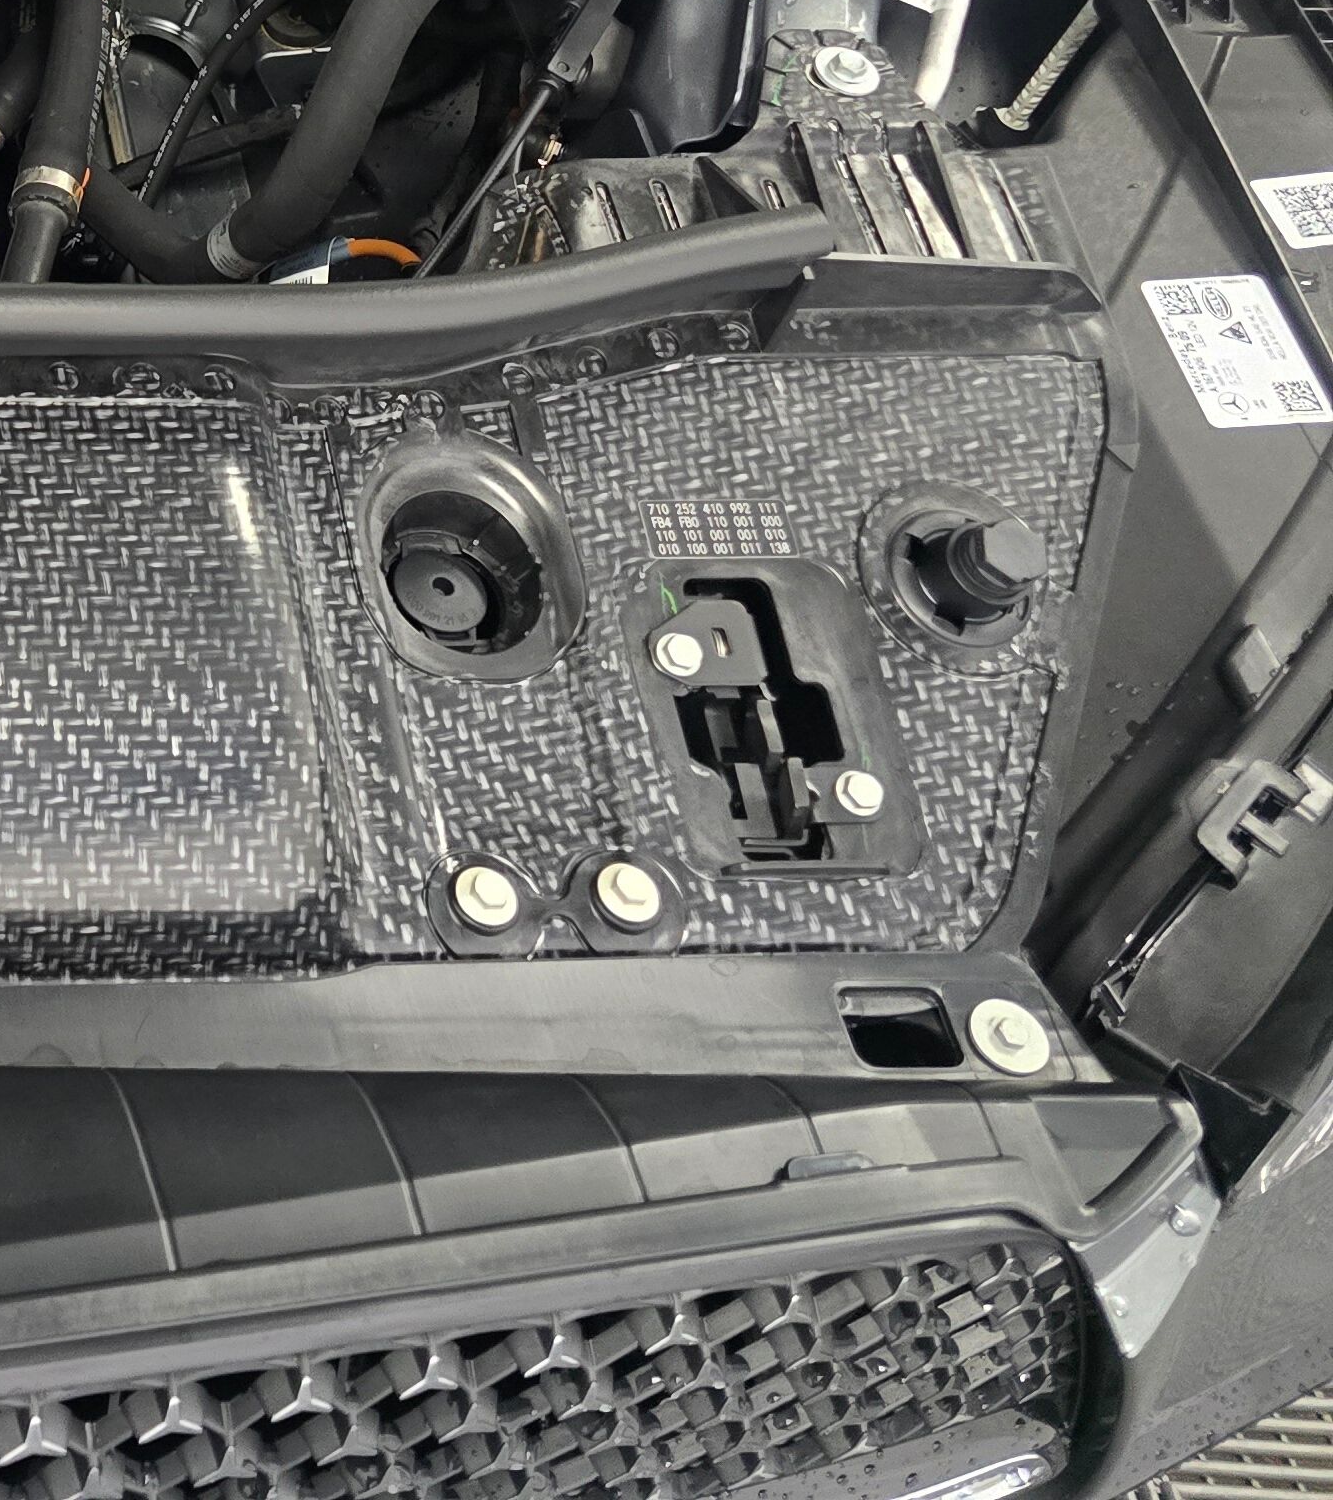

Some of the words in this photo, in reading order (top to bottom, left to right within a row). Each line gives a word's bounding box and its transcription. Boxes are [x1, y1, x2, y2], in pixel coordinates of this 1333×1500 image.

[647, 504, 669, 514] 710
[675, 504, 696, 515] 252
[703, 503, 724, 514] 410
[730, 503, 751, 514] 992
[758, 503, 778, 514] 111
[651, 517, 672, 529] FB4
[707, 517, 728, 527] 110
[734, 516, 755, 527] 001
[761, 516, 782, 527] 000
[656, 530, 676, 542] 110
[684, 530, 703, 541] 101
[710, 530, 730, 541] 001
[737, 530, 758, 540] 001
[765, 529, 787, 540] 010
[658, 544, 680, 555] 010
[687, 543, 708, 555] 100
[713, 543, 734, 554] 001
[741, 543, 763, 554] 011
[769, 543, 791, 554] 138
